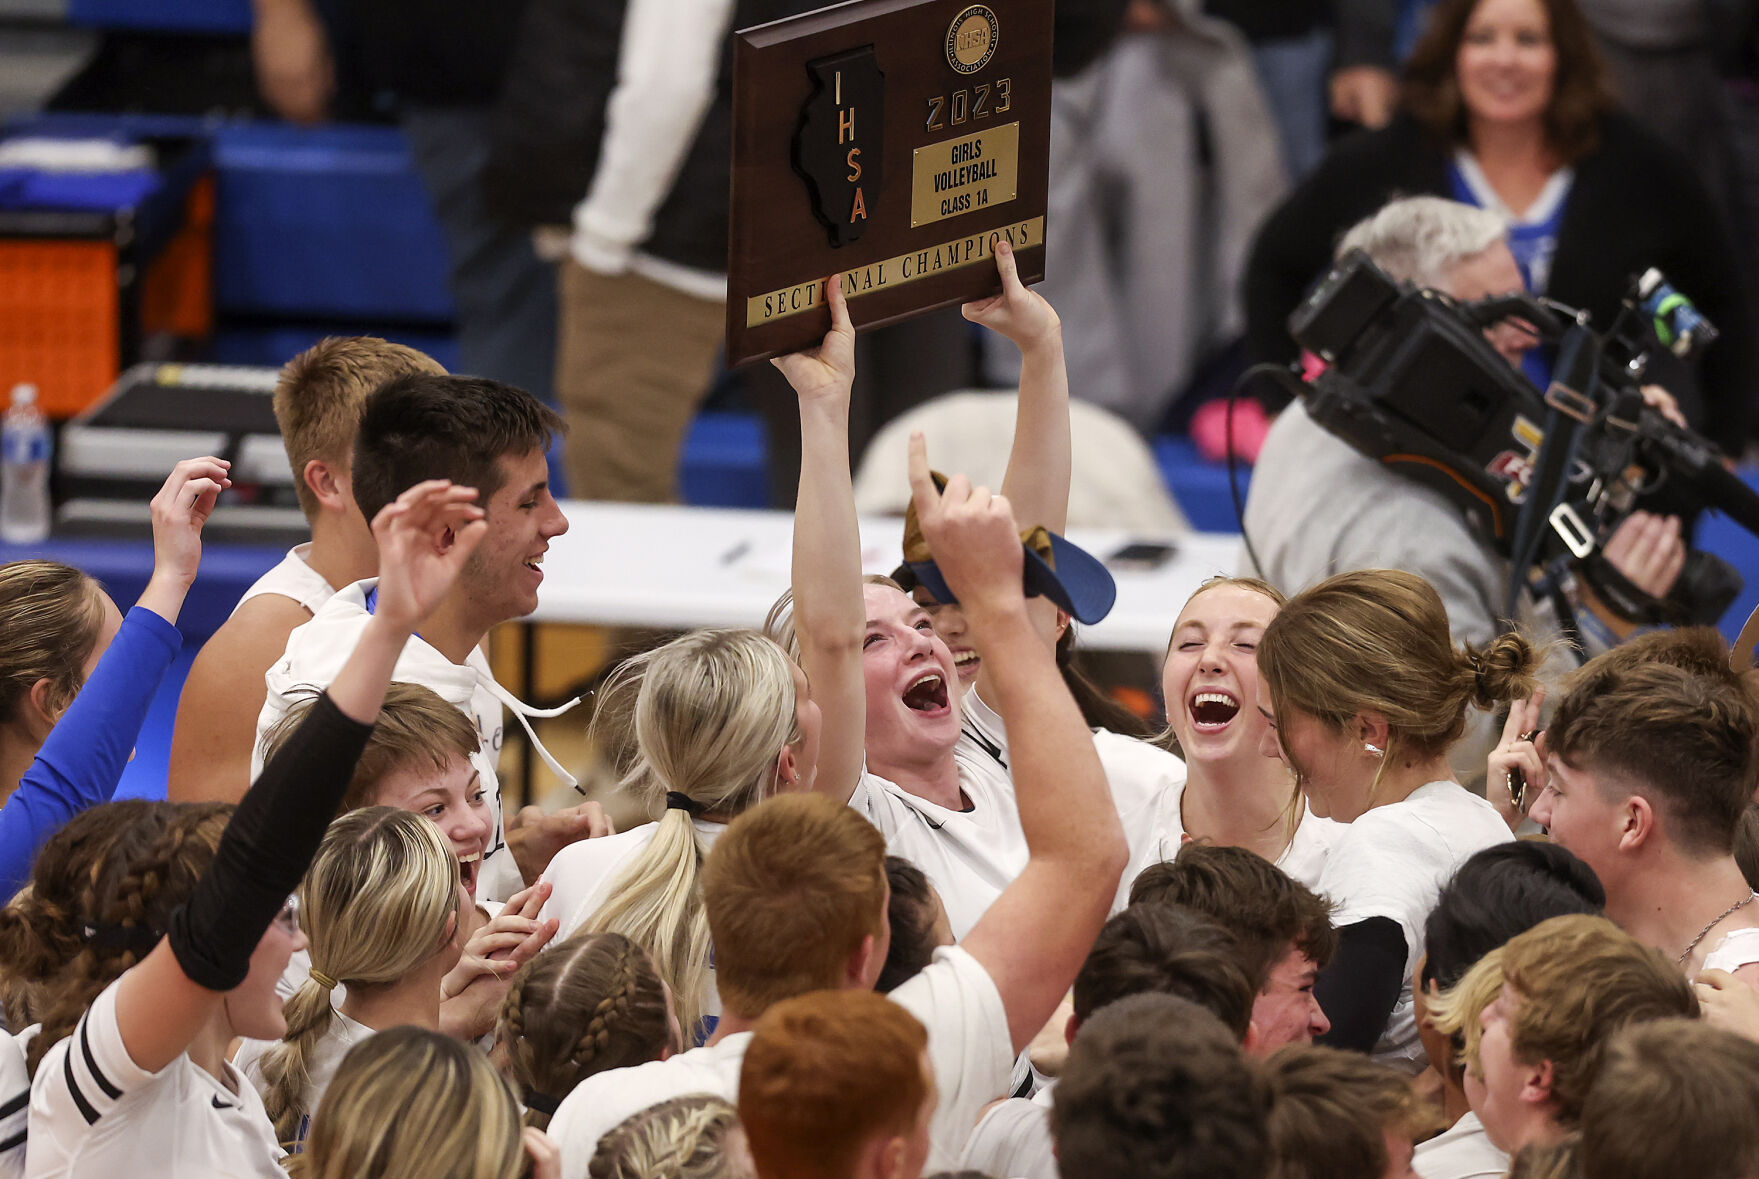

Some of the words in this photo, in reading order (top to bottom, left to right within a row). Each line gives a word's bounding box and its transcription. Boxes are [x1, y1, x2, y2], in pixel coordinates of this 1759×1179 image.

[948, 18, 964, 54] ILLINOIS
[965, 9, 983, 17] HIGH
[985, 11, 997, 42] SCHOOL
[951, 49, 992, 71] ASSOCIATION
[926, 78, 1011, 132] 2023
[951, 139, 982, 165] GIRLS
[934, 159, 997, 192] VOLLEYBALL
[941, 193, 971, 216] CLASS
[976, 189, 988, 206] 1A
[764, 264, 887, 318] SECTINAL
[902, 223, 1028, 278] CHAMPIONS
